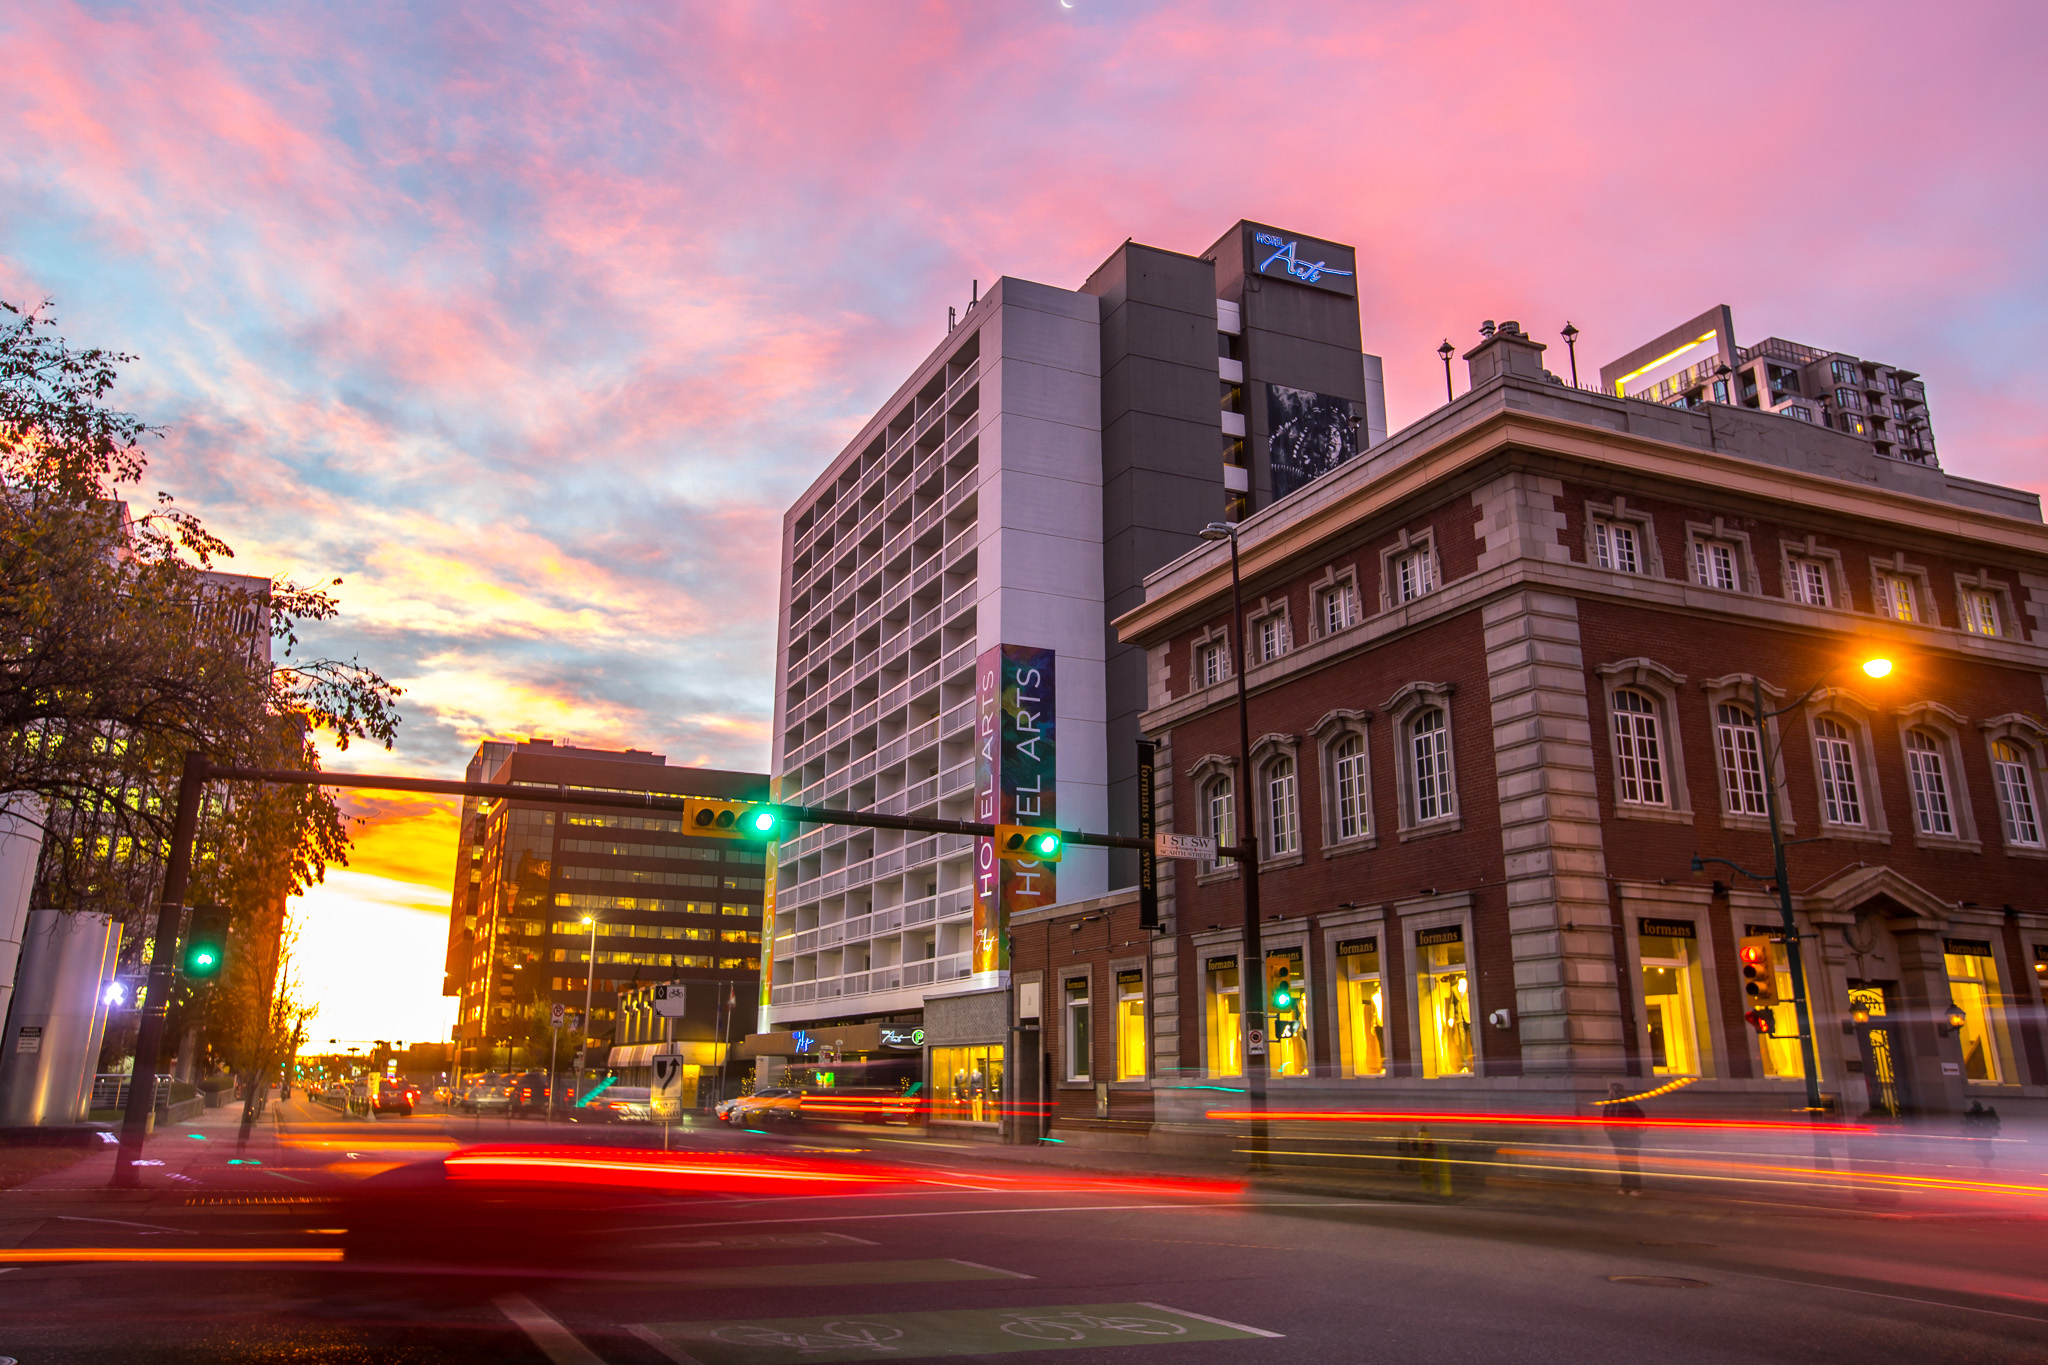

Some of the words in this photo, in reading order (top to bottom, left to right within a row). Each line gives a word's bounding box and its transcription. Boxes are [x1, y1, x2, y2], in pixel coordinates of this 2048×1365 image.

[1256, 232, 1285, 248] HOTEL
[982, 670, 994, 761] ARTS
[1016, 668, 1041, 761] ARTS
[1141, 764, 1153, 818] formans
[980, 775, 993, 898] HOEL
[1016, 775, 1041, 895] HEL
[1191, 838, 1210, 848] SW
[764, 867, 775, 953] HOTEL
[1643, 919, 1691, 936] formans
[1419, 930, 1458, 945] formans
[1339, 941, 1374, 955] formans
[1948, 940, 1988, 955] formans
[1208, 959, 1235, 971] formans
[1066, 979, 1087, 990] formans
[1119, 972, 1141, 983] formans
